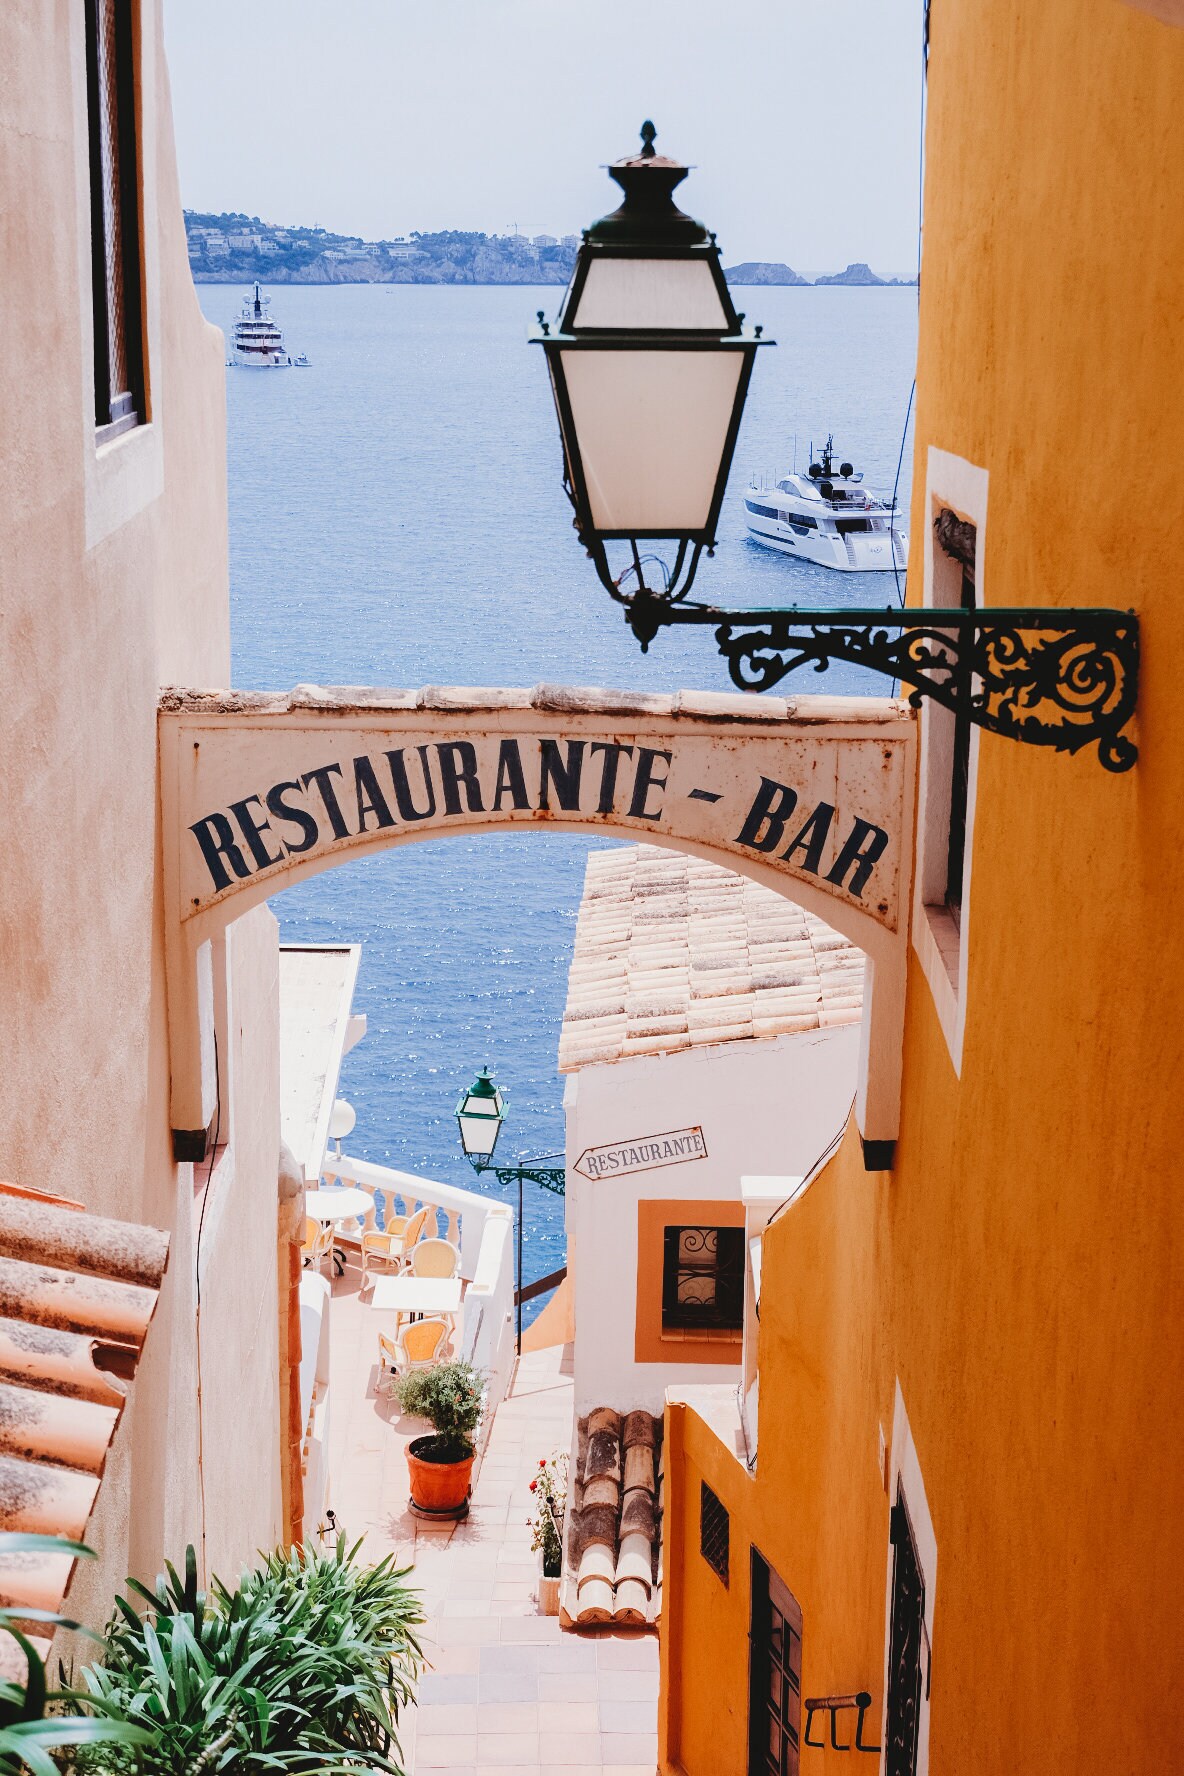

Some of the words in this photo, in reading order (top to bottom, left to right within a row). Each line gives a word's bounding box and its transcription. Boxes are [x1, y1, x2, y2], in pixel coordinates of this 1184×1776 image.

[187, 739, 673, 893] RESTAURANTE
[732, 775, 889, 899] BAR
[586, 1134, 703, 1176] RESTAURANTE
